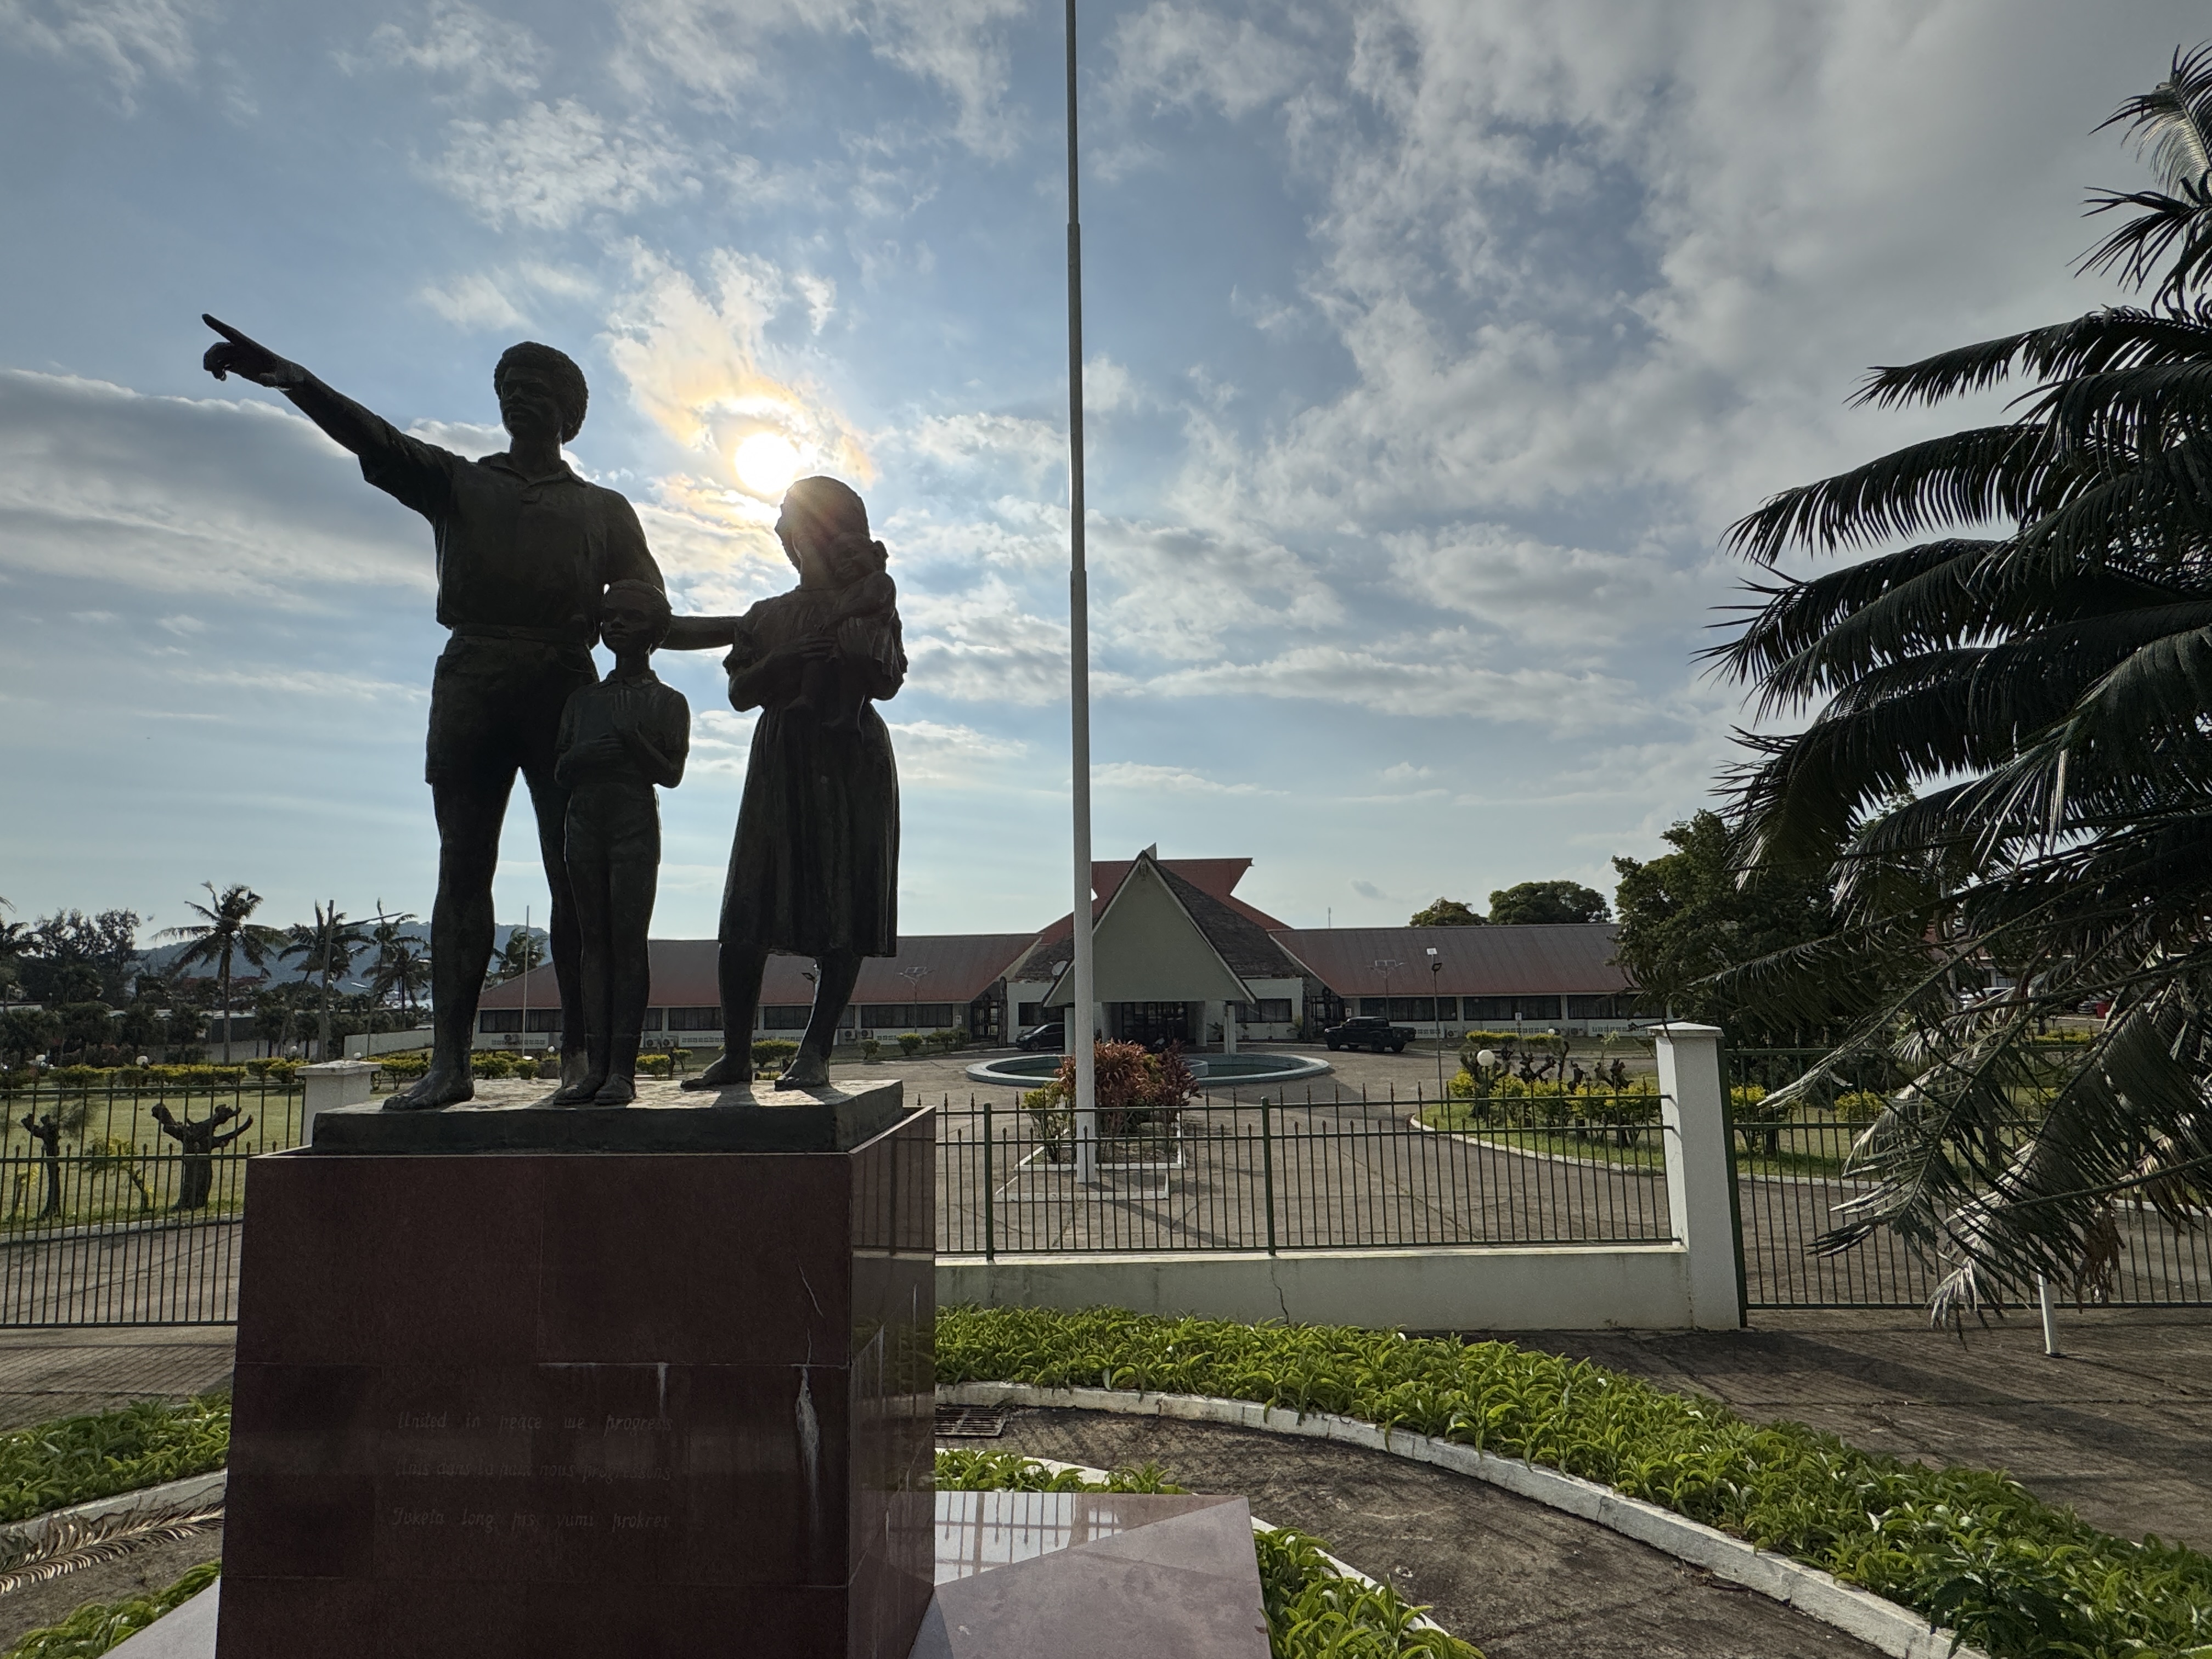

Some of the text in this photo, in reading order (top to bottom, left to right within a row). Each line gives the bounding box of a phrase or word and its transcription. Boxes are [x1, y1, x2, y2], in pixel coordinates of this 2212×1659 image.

[398, 1410, 673, 1437] United in peace we progress
[460, 1508, 493, 1533] long
[612, 1510, 670, 1533] prokres
